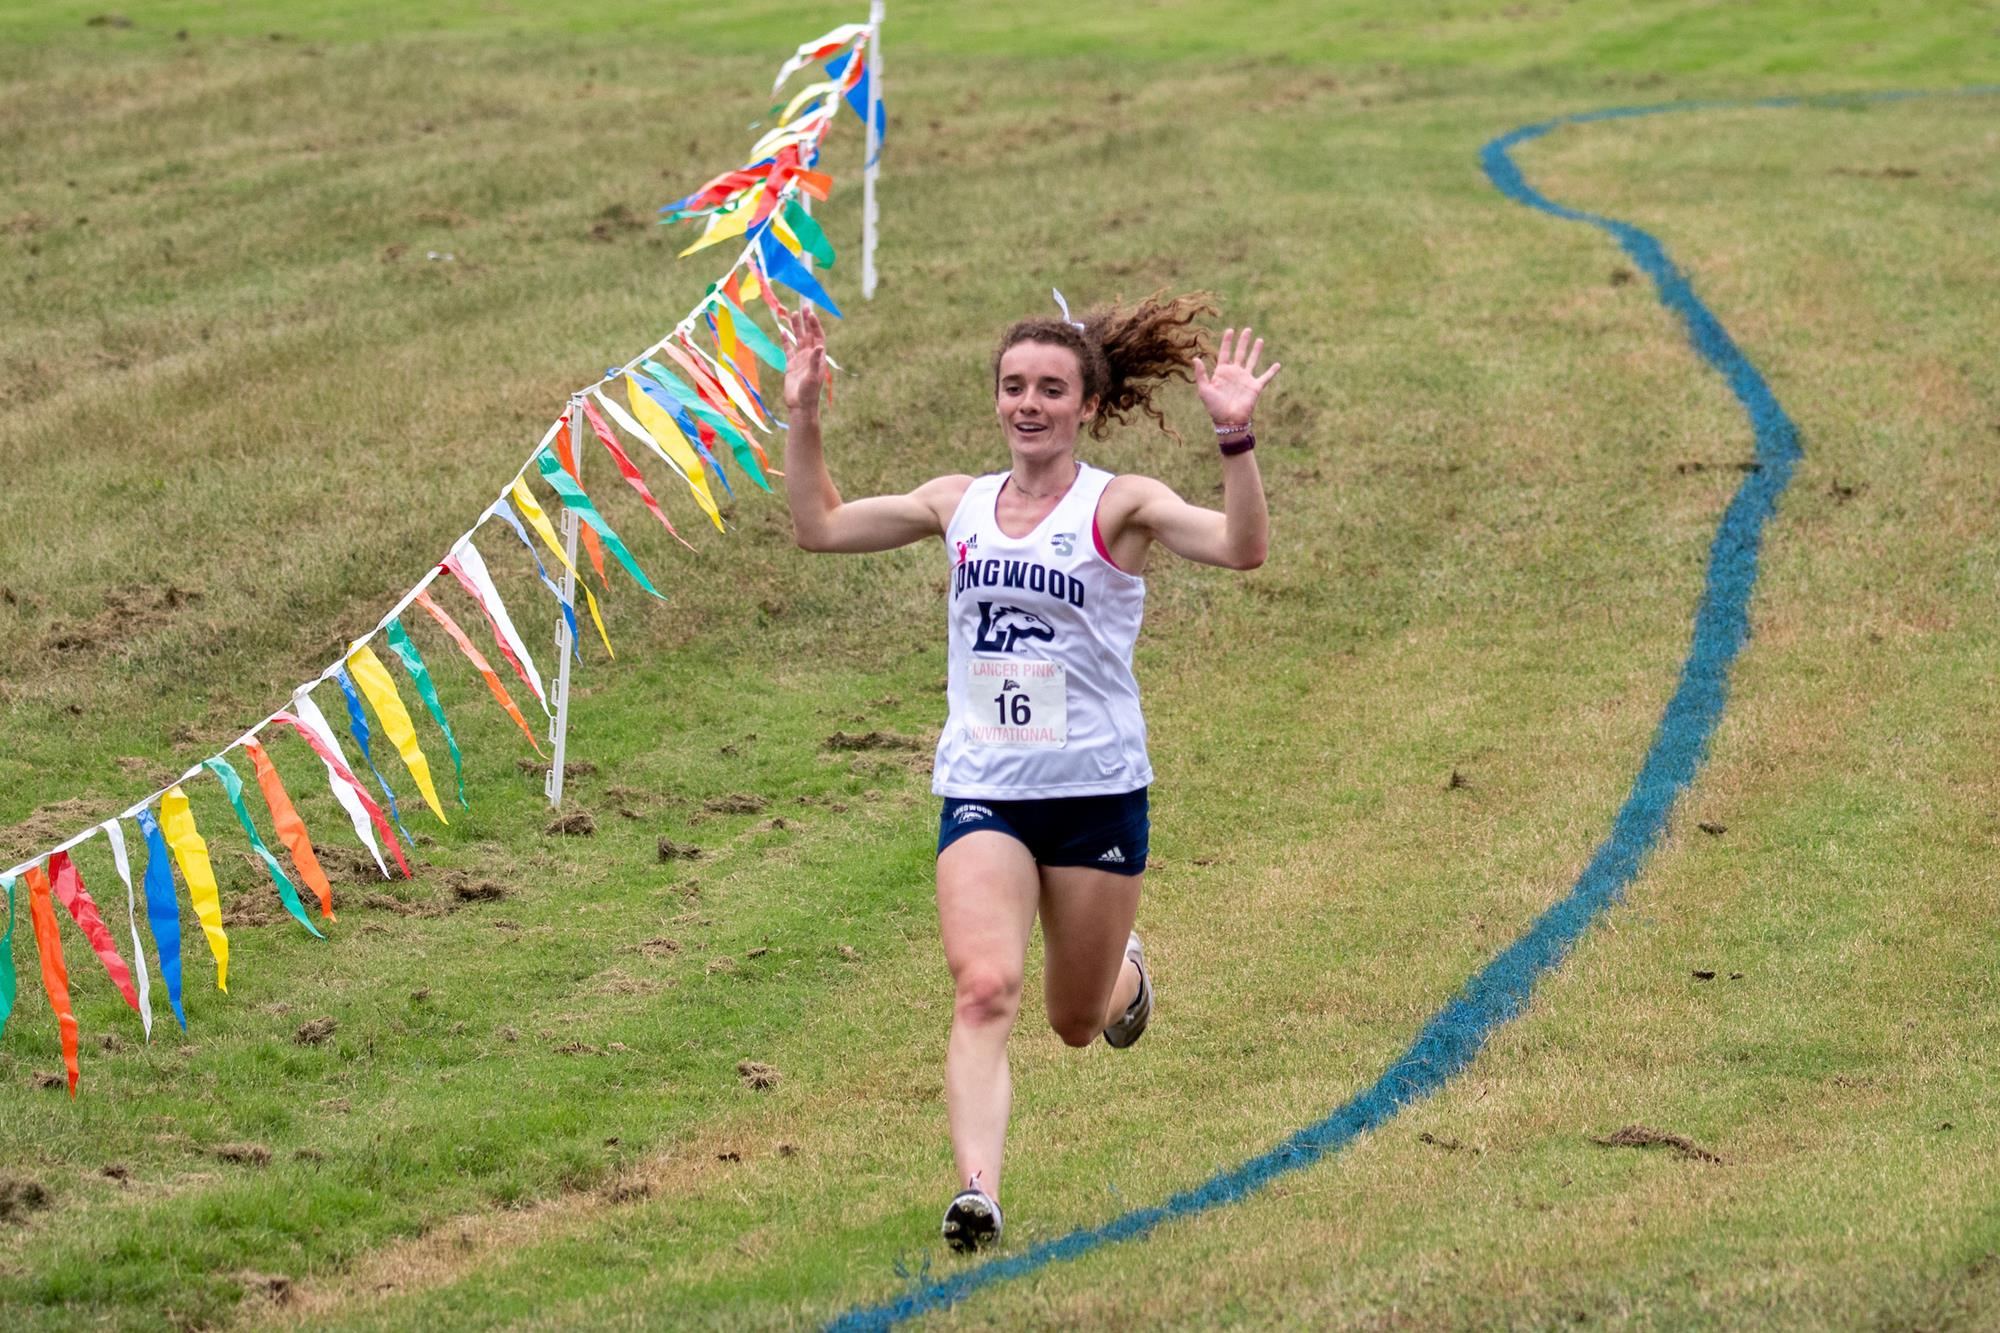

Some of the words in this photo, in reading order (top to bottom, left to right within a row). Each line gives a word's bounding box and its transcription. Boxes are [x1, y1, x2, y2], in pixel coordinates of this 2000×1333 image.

[955, 559, 1084, 608] ONGWOOD
[973, 663, 1018, 677] LANCER
[1024, 664, 1055, 678] PINK
[994, 693, 1031, 726] 16
[972, 727, 1056, 741] INVITATIONAL
